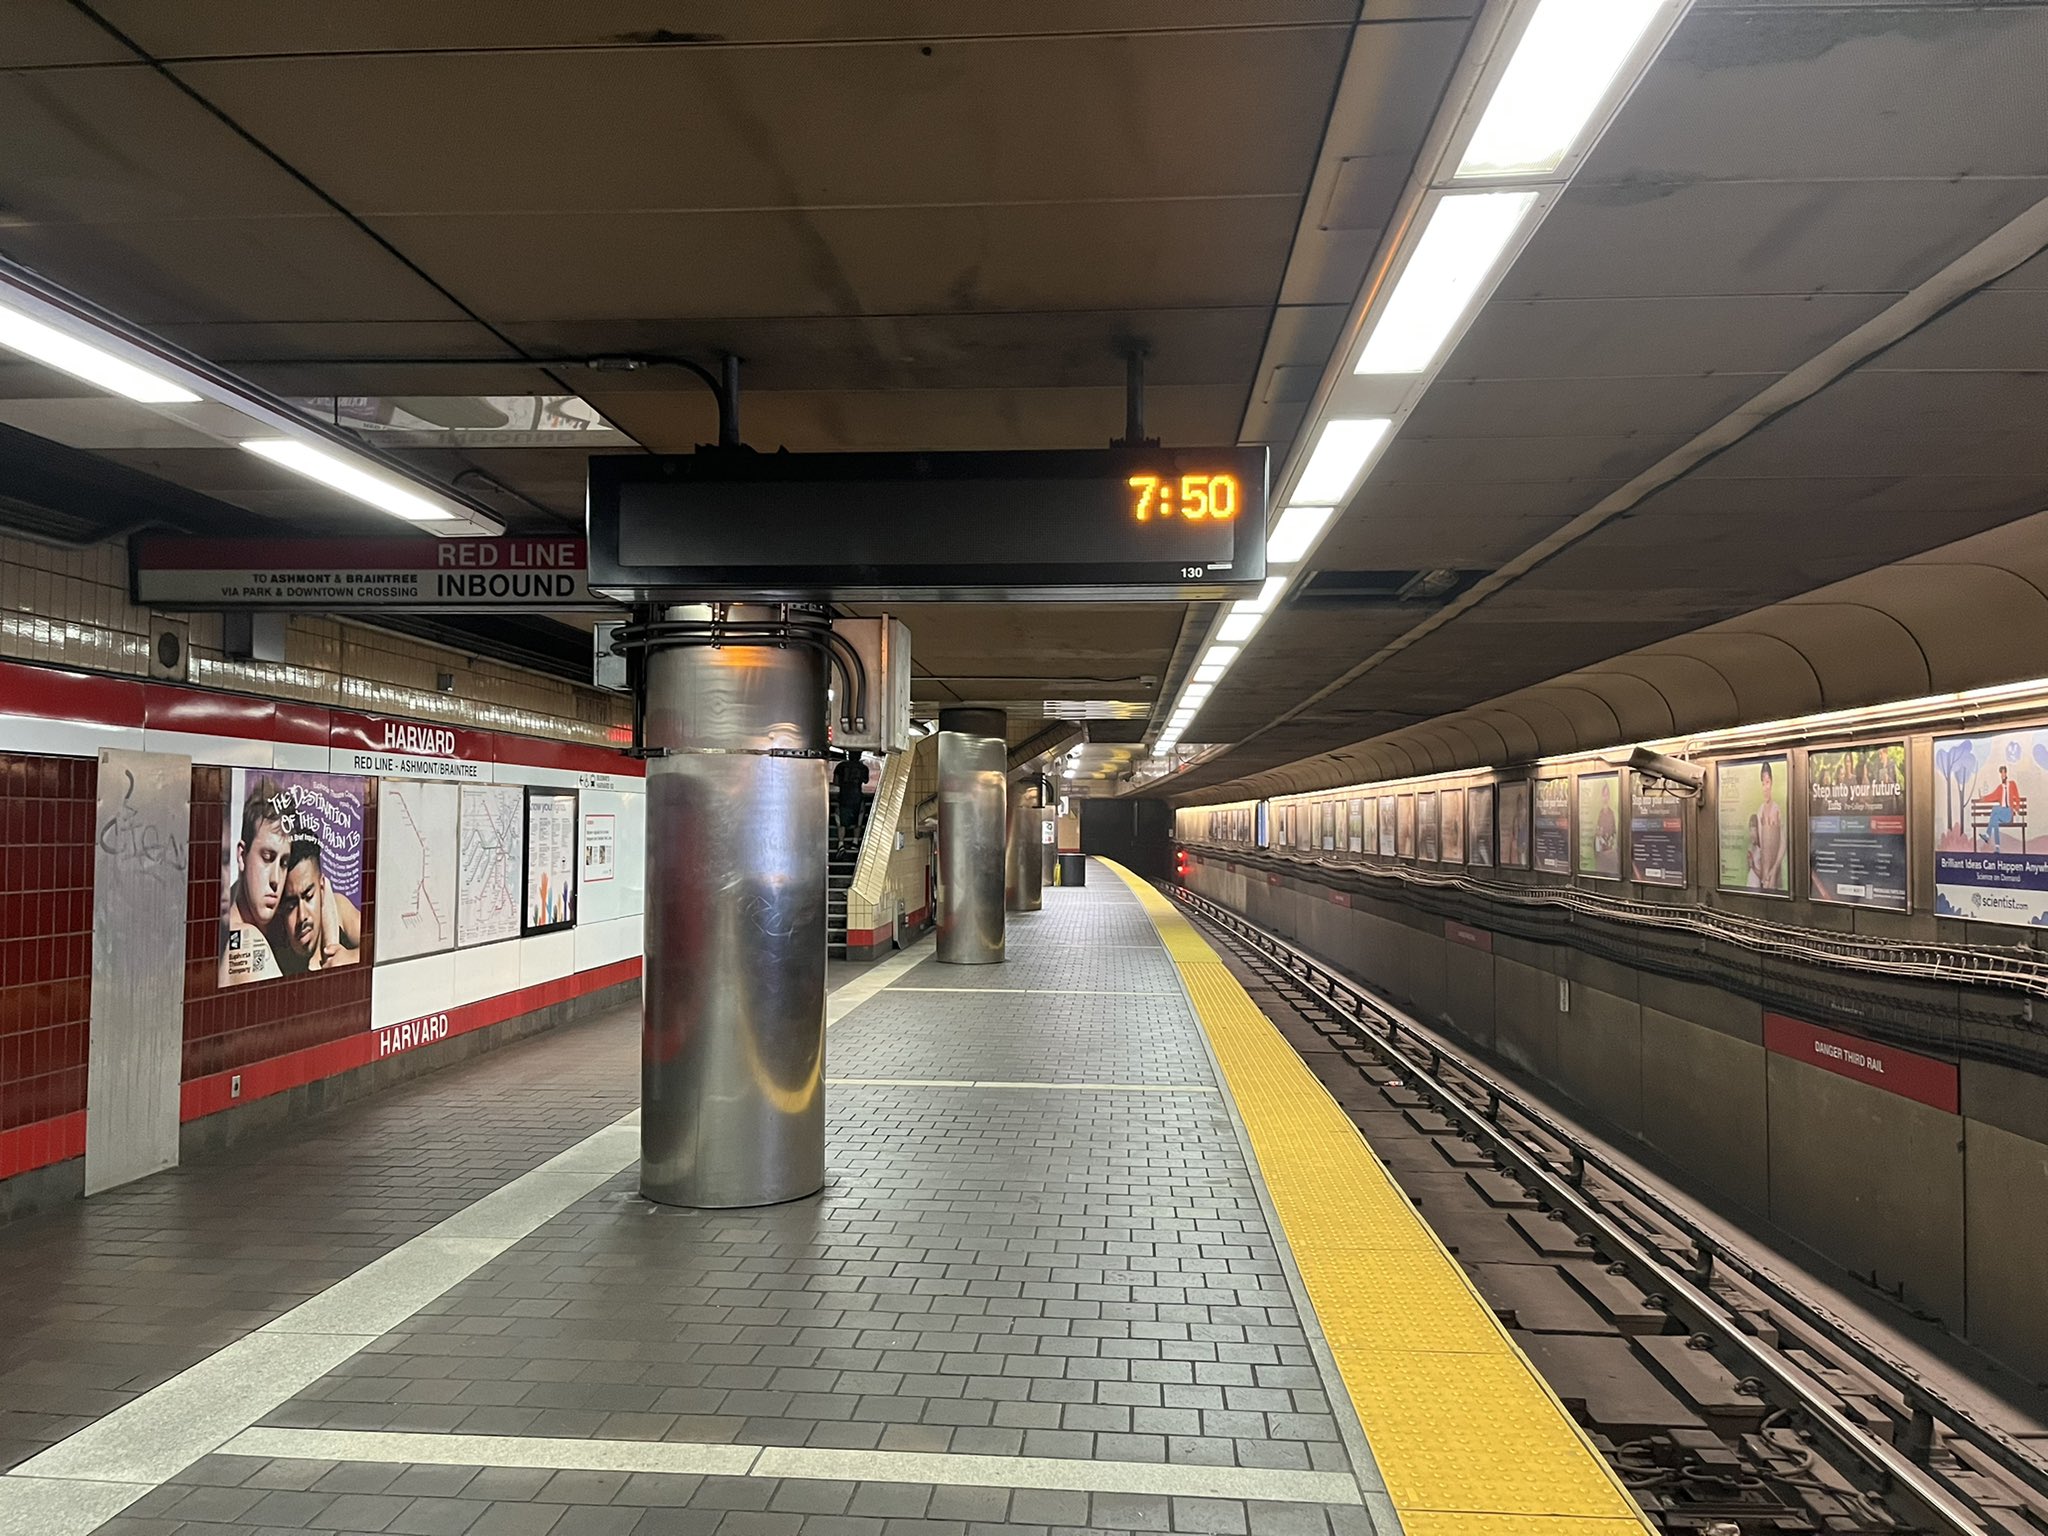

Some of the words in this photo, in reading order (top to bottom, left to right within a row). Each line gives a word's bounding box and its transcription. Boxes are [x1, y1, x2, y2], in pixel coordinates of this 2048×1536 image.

[1129, 475, 1235, 520] 7:50
[437, 543, 499, 566] RED
[510, 543, 576, 566] LINE
[252, 574, 268, 583] TO
[270, 574, 331, 583] ASHMONT
[335, 574, 343, 583] &
[346, 574, 419, 583] BRAINTREE
[1181, 567, 1203, 578] 130
[221, 587, 240, 597] VIA
[243, 587, 273, 597] PARK
[276, 587, 284, 597] &
[287, 587, 354, 597] DOWNTOWN
[357, 587, 419, 597] CROSSING
[437, 574, 576, 597] INBOUND
[385, 723, 455, 754] HARVARD
[354, 756, 373, 770] RED
[375, 758, 393, 771] LINE
[400, 760, 478, 777] ASHMONT/BRAINTREE
[1813, 783, 1831, 801] Step
[1832, 782, 1849, 797] into
[1849, 784, 1870, 801] your
[1872, 780, 1901, 796] future
[267, 791, 292, 815] THE
[281, 814, 296, 834] OF
[296, 810, 320, 832] THIS
[321, 818, 346, 849] TRAIN
[346, 830, 361, 852] IS
[1941, 858, 1964, 869] Brilliant
[1965, 859, 1982, 870] Ideas
[1983, 860, 1996, 870] Can
[1997, 861, 2023, 873] Happen
[1982, 893, 2029, 910] scientist.com
[380, 1014, 448, 1057] HARVARD
[1815, 1041, 1843, 1060] DANGER
[1843, 1049, 1865, 1067] THIRD
[1866, 1057, 1885, 1073] RAIL
